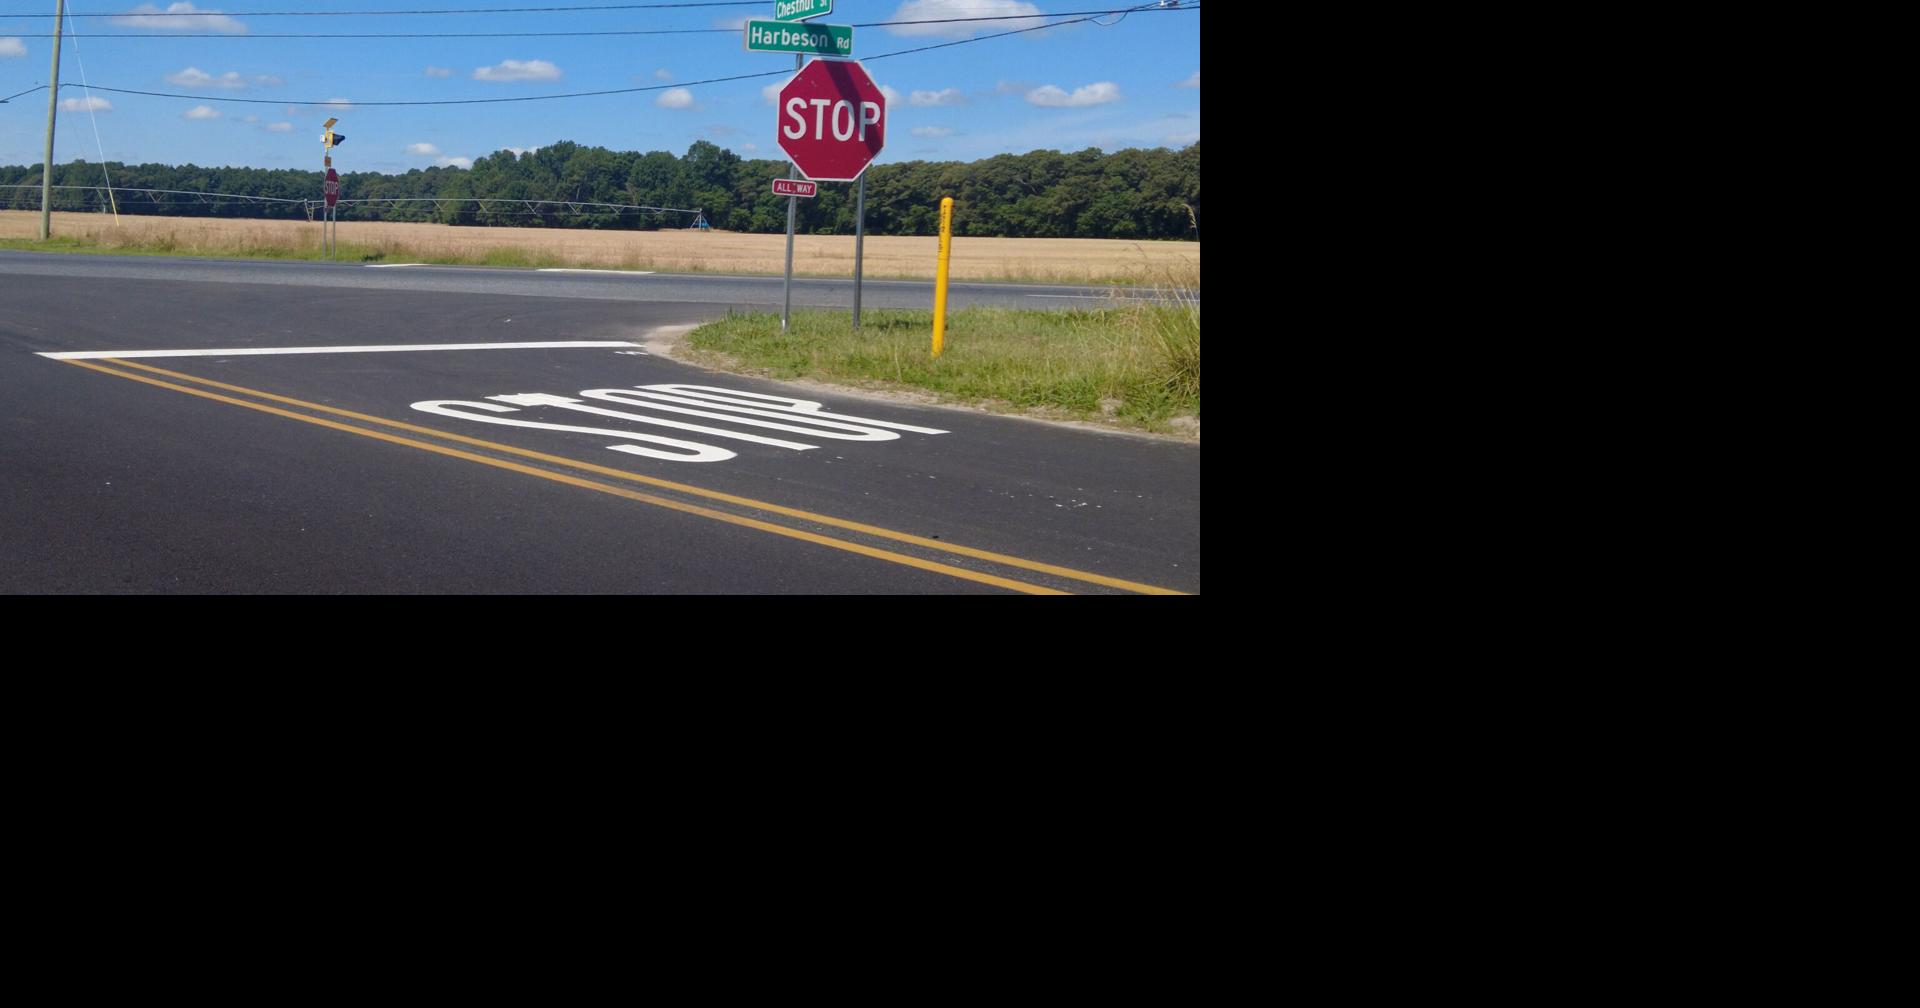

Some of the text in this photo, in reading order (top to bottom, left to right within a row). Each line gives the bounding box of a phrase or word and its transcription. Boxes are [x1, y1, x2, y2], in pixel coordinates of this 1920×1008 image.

[777, 0, 814, 18] Chestnut
[752, 27, 850, 49] Harbeson Rd
[783, 97, 881, 142] STOP
[325, 180, 339, 195] STOP
[776, 183, 813, 194] ALL WAY
[409, 383, 953, 463] STOP
